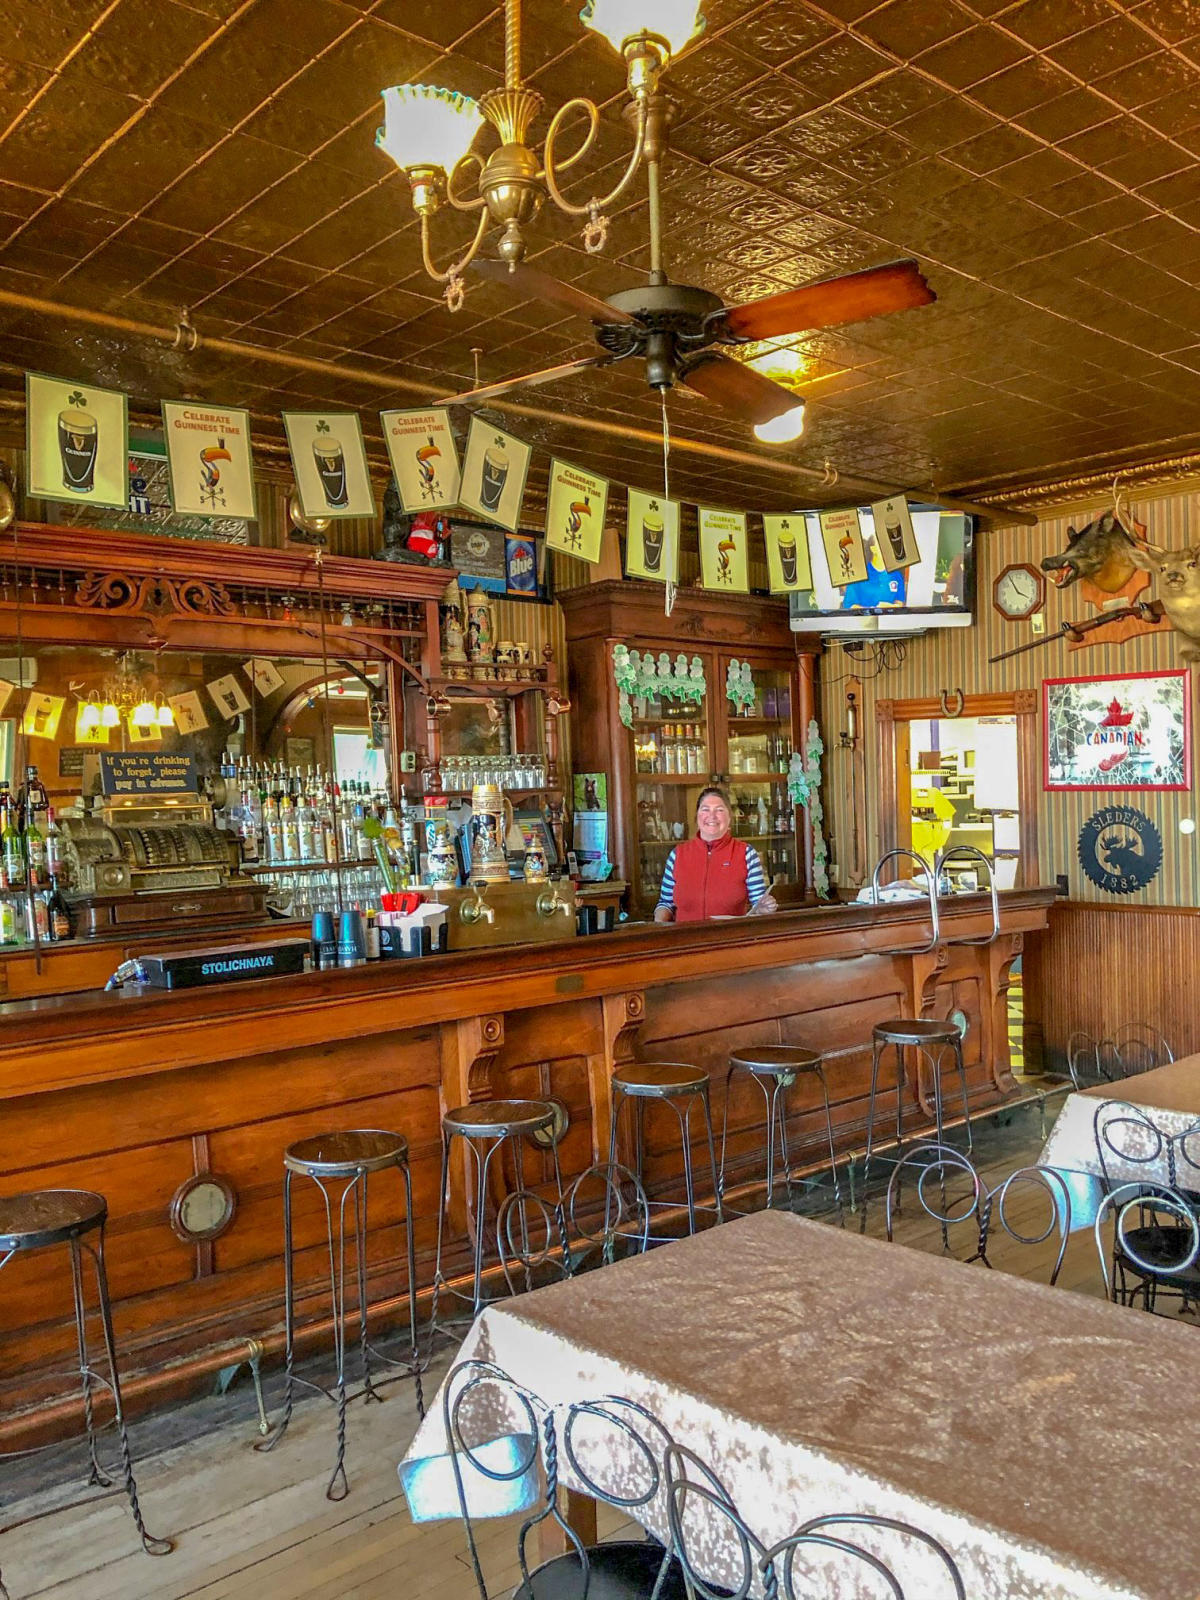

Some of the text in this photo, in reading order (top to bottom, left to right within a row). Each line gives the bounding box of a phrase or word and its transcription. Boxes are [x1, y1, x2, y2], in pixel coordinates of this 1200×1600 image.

[183, 411, 231, 424] CELEBRATE
[398, 416, 435, 425] CELEBRATE
[174, 420, 241, 435] GUINNESS TIME
[392, 426, 427, 436] GUINNESS
[564, 469, 597, 488] CELEBRATE
[557, 475, 602, 498] GUINNESS TIME
[509, 555, 533, 577] Blue
[1086, 730, 1144, 746] CANADIAN
[106, 755, 191, 768] If you're drinking
[113, 766, 187, 778] to forget, please
[1092, 811, 1146, 832] SLEDERS
[1101, 874, 1139, 889] 1882
[201, 956, 274, 975] STOLICHNAYA
